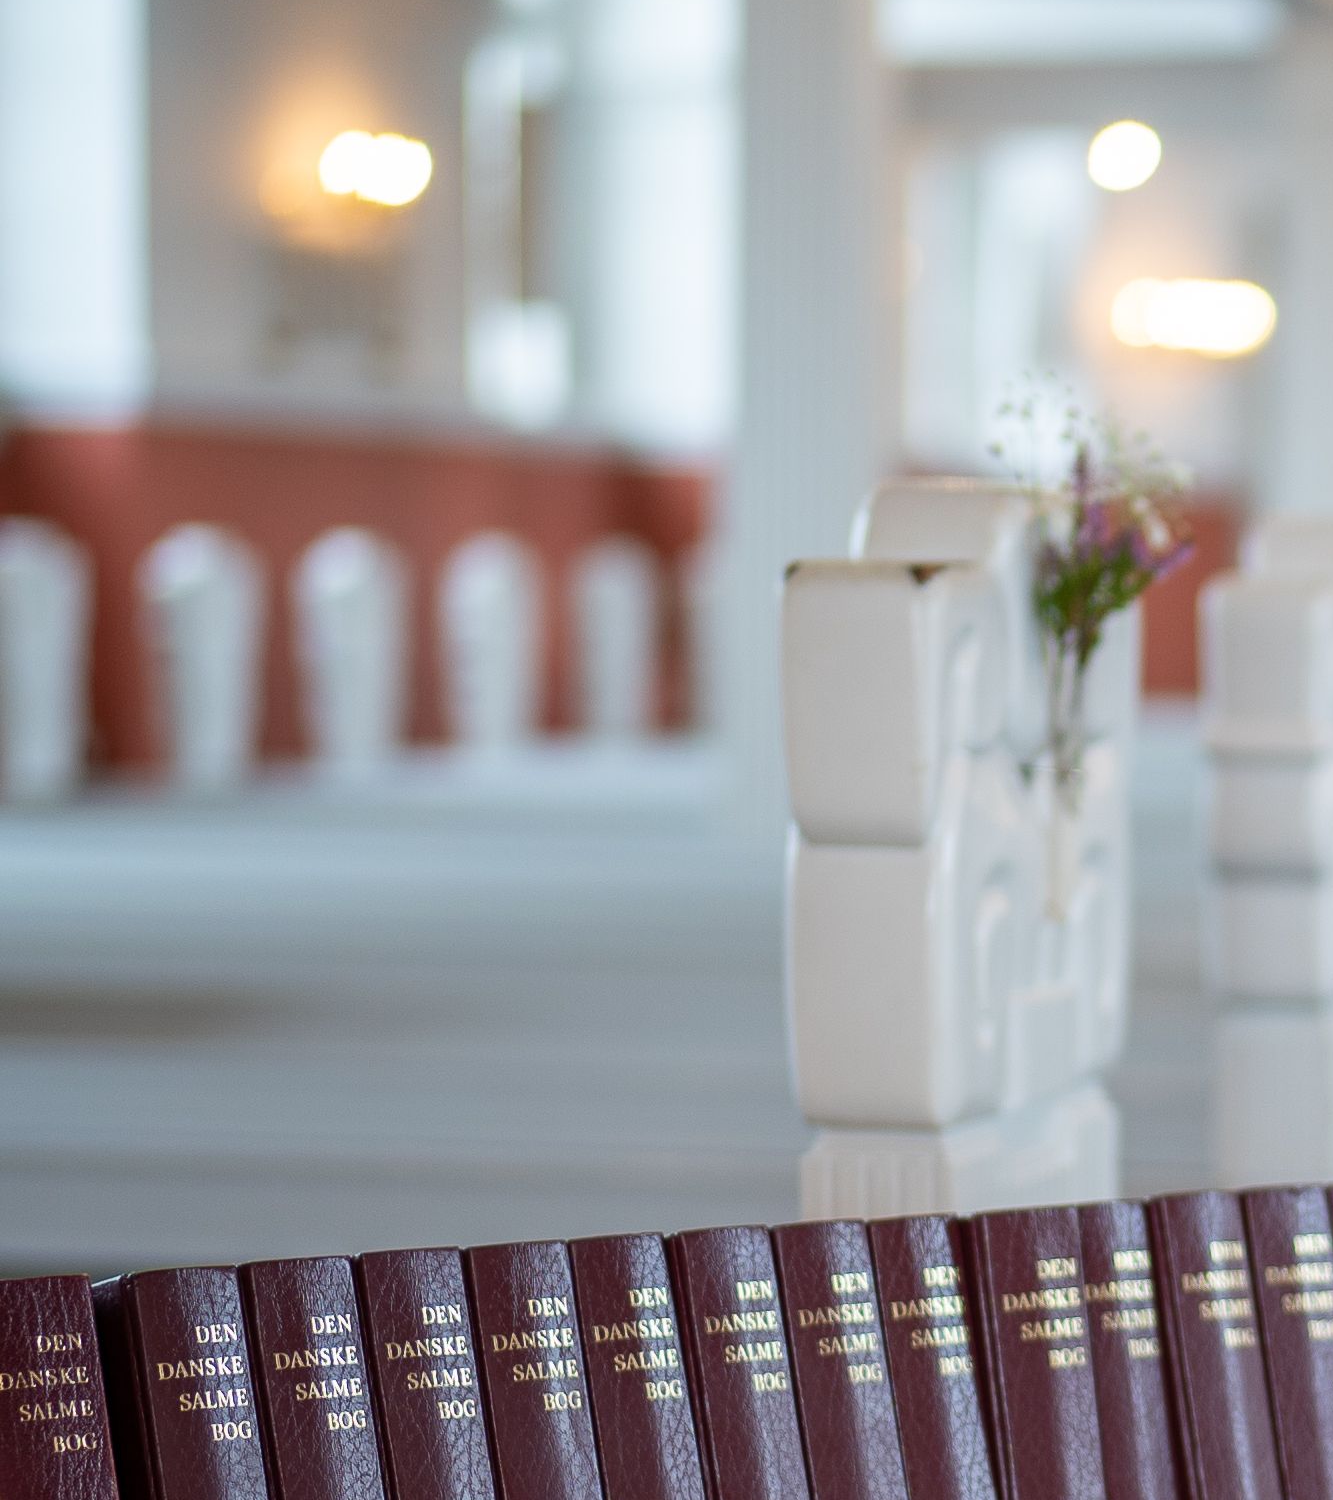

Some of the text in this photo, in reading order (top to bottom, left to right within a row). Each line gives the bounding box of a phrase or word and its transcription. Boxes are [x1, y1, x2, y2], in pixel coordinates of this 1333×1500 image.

[924, 1265, 959, 1287] DEN
[1036, 1257, 1076, 1279] DEN
[736, 1278, 773, 1300] DEN
[831, 1271, 869, 1293] DEN
[528, 1297, 568, 1318] DEN
[629, 1287, 668, 1307] DEN
[1002, 1288, 1080, 1312] DANSKE
[311, 1313, 352, 1335] DEN
[422, 1304, 462, 1325] DEN
[704, 1311, 778, 1333] DANSKE
[799, 1302, 873, 1326] DANSKE
[195, 1322, 237, 1344] DEN
[491, 1328, 574, 1352] DANSKE
[593, 1318, 673, 1342] DANSKE
[1021, 1317, 1083, 1341] SALME
[36, 1334, 82, 1354] DEN
[386, 1336, 468, 1359] DANSKE
[725, 1341, 782, 1362] SALME
[819, 1333, 878, 1356] SALME
[157, 1355, 244, 1380] DANSKE
[274, 1346, 357, 1370] DANSKE
[614, 1349, 678, 1371] SALME
[940, 1355, 973, 1376] BOG
[1049, 1347, 1085, 1368] BOG
[0, 1365, 88, 1392] DANSKE
[407, 1368, 473, 1389] SALME
[513, 1360, 579, 1381] SALME
[753, 1371, 786, 1391] BOG
[848, 1363, 882, 1384] BOG
[179, 1388, 248, 1412] SALME
[295, 1379, 363, 1401] SALME
[543, 1390, 582, 1411] BOG
[646, 1379, 683, 1400] BOG
[19, 1399, 94, 1421] SALME
[327, 1410, 366, 1431] BOG
[438, 1400, 476, 1420] BOG
[53, 1432, 98, 1453] BOG
[211, 1421, 252, 1442] BOG
